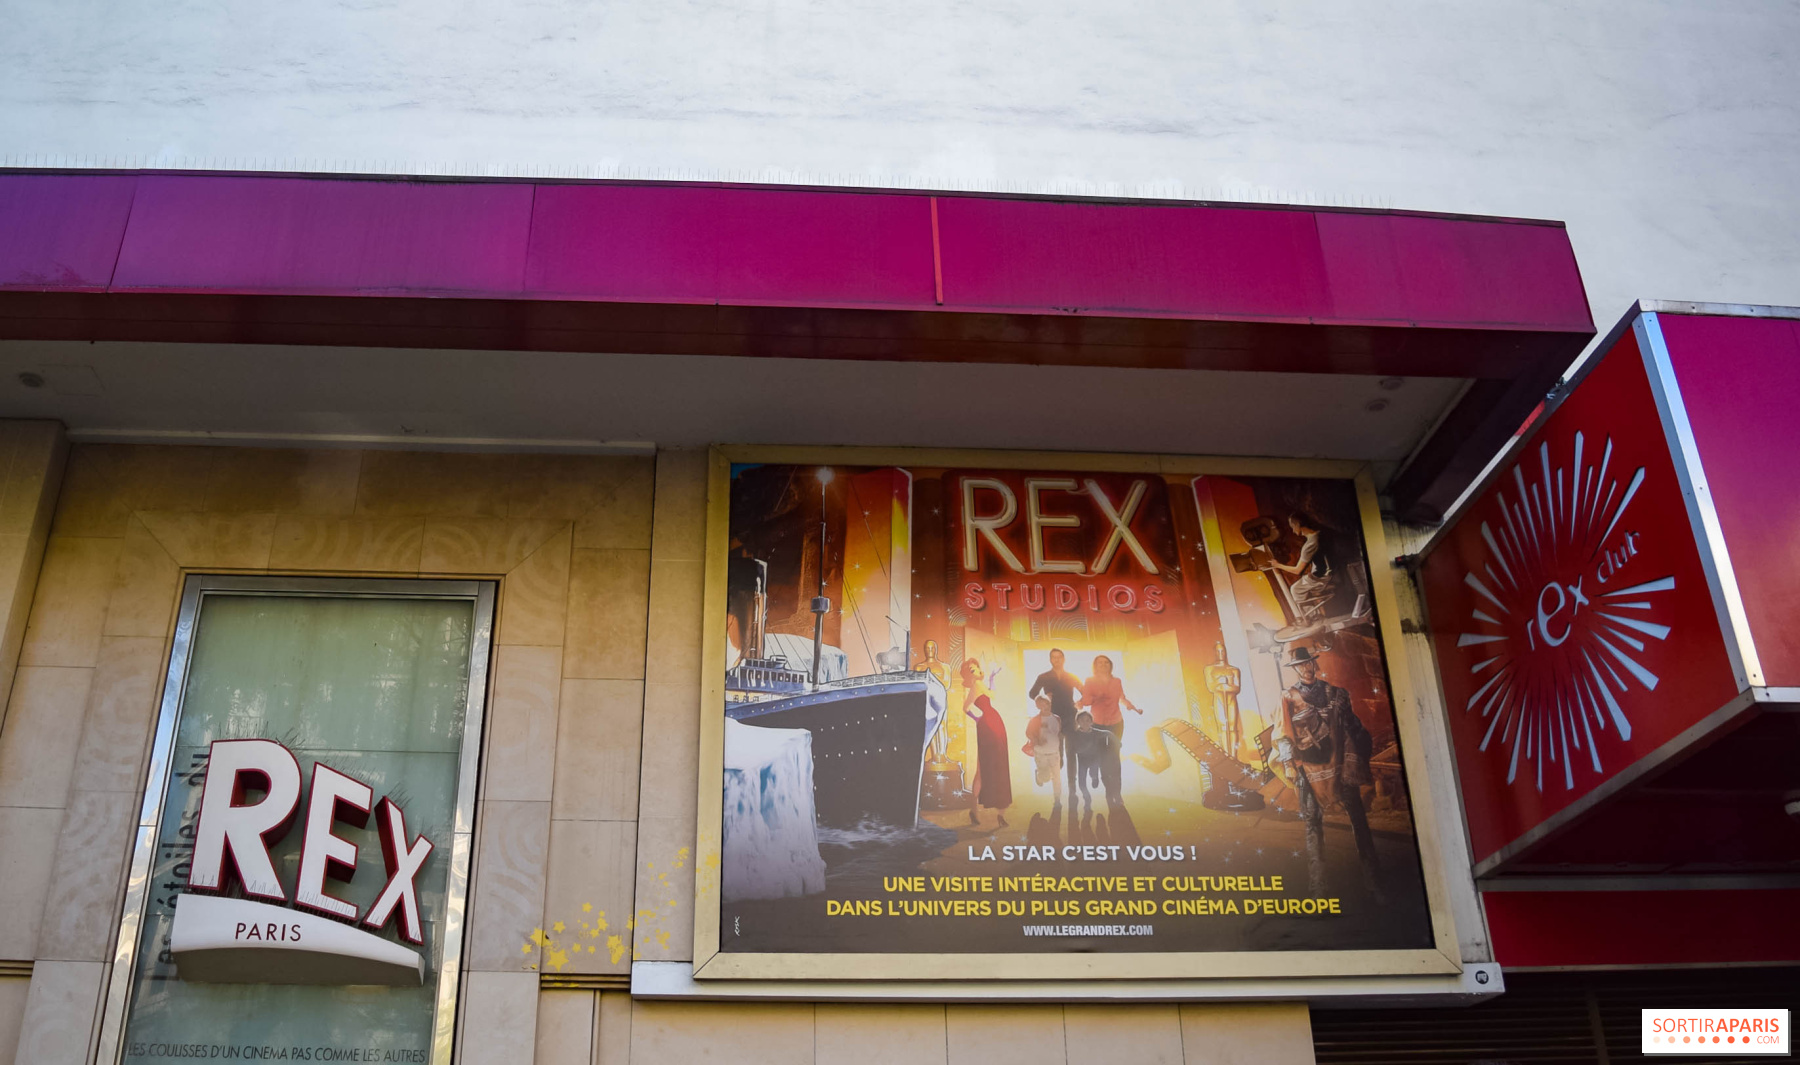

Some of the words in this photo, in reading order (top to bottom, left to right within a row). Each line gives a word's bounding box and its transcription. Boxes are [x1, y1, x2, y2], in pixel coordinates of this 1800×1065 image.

[961, 476, 1159, 574] REX
[964, 582, 1165, 613] STUDIOS
[1527, 574, 1590, 650] rex
[187, 738, 435, 946] REX
[968, 846, 996, 861] LA
[1002, 846, 1056, 861] STAR
[1062, 846, 1120, 861] C'EST
[1126, 845, 1185, 861] VOUS
[1190, 845, 1197, 861] !
[883, 876, 925, 892] UNE
[930, 876, 994, 892] VISITE
[999, 873, 1129, 892] INTÉRACTIVE
[1133, 876, 1157, 892] ET
[1162, 875, 1284, 892] CULTURELLE
[826, 900, 883, 916] DANS
[888, 900, 992, 916] L'UNIVERS
[997, 900, 1025, 916] DU
[1031, 900, 1081, 916] PLUS
[1085, 899, 1157, 916] GRAND
[1162, 896, 1240, 916] CINÉMA
[1244, 898, 1341, 915] D'EUROPE
[234, 922, 302, 942] PARIS
[1023, 925, 1153, 937] WWW.LEGRANDREX.COM
[128, 1042, 146, 1056] LES
[148, 1043, 208, 1058] COULISSES
[210, 1045, 240, 1058] D'UN
[242, 1045, 287, 1060] CINEMA
[290, 1046, 311, 1060] PAS
[314, 1047, 359, 1061] COMME
[362, 1048, 380, 1062] LES
[383, 1048, 426, 1063] AUTRES
